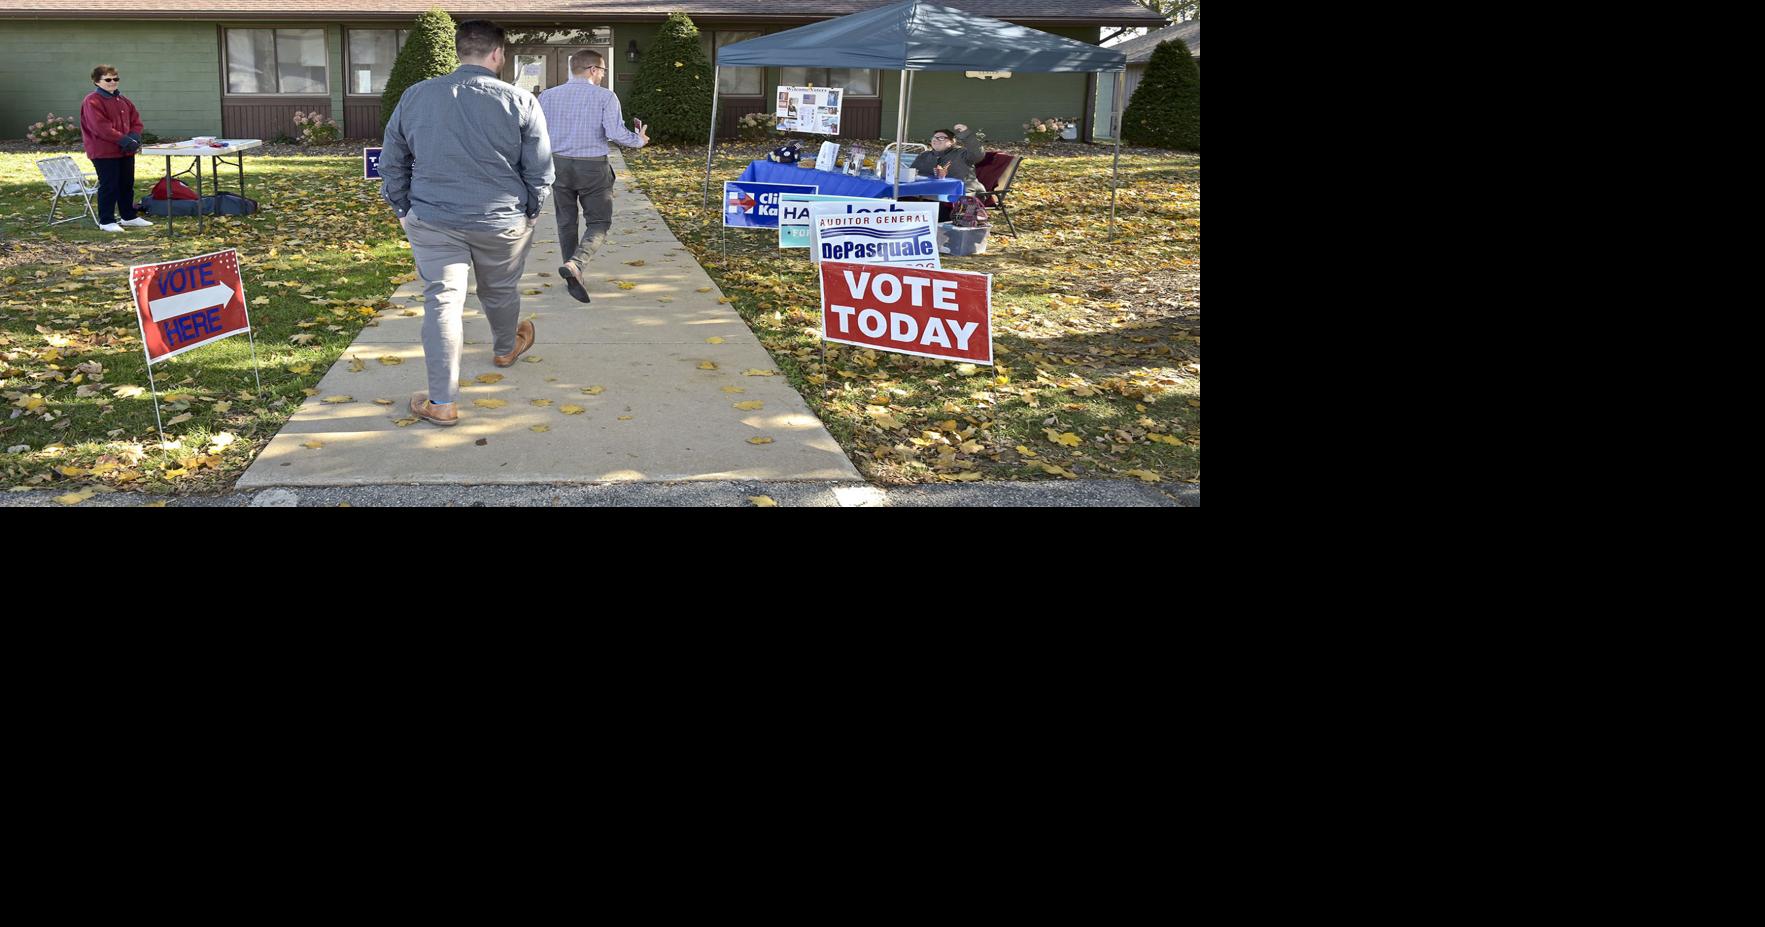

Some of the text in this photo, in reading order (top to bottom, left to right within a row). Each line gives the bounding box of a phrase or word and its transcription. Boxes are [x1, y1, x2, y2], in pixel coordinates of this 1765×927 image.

[820, 214, 929, 227] AUDITOR GENERAL
[821, 236, 934, 262] DePasquale
[157, 261, 215, 296] VOTE
[843, 270, 959, 312] VOTE
[164, 308, 223, 346] HERE
[830, 304, 979, 351] TODAY
